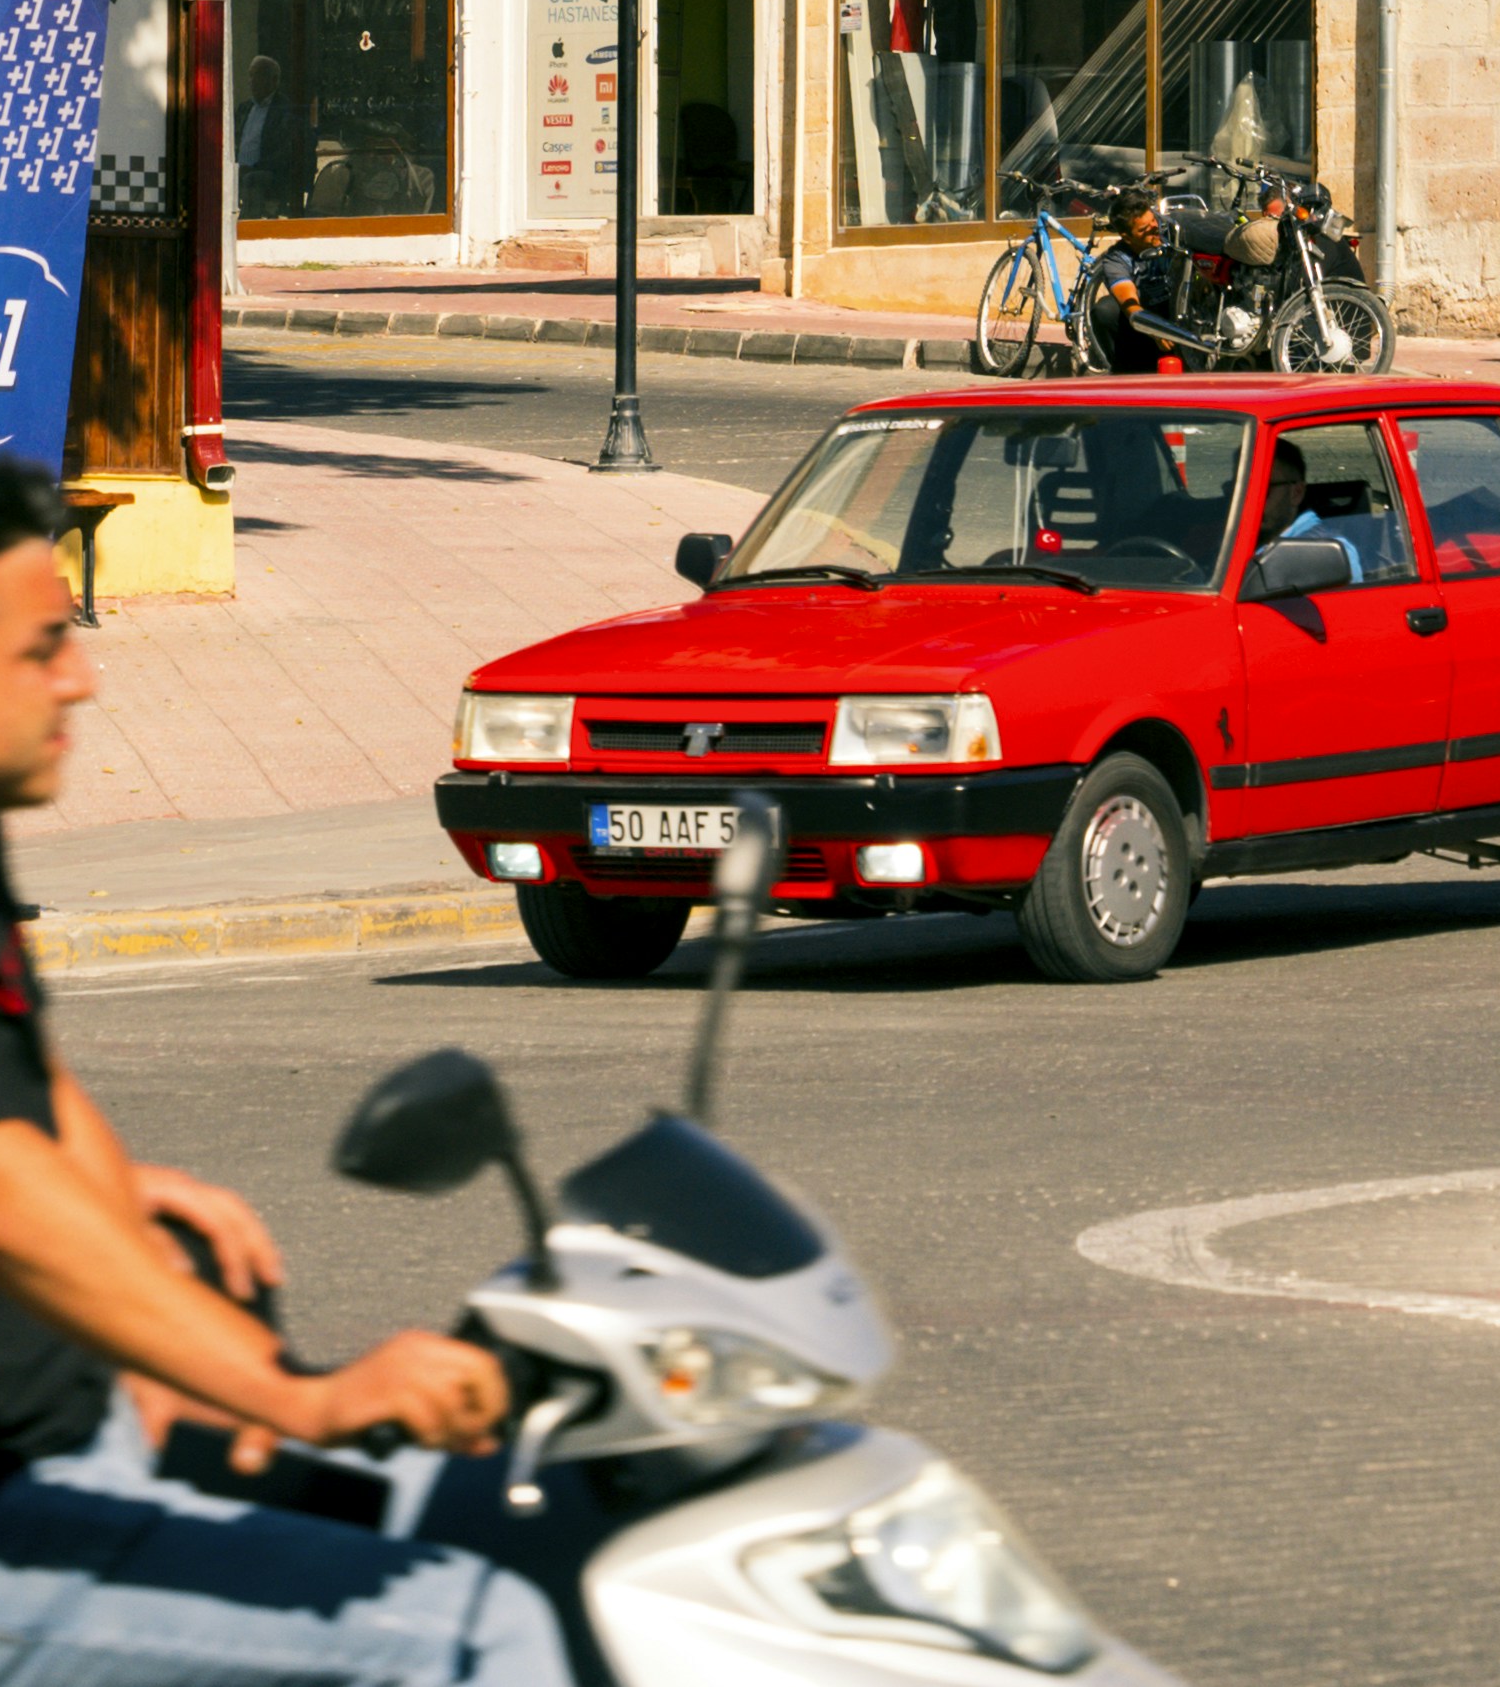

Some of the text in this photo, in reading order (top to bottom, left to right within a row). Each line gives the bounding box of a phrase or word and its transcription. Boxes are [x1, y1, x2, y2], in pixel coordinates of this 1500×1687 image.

[547, 5, 619, 24] HASTANES
[29, 29, 59, 63] +1
[66, 31, 97, 66] +1
[6, 60, 36, 95] +1
[43, 62, 72, 97] +1
[22, 94, 50, 128] +1
[57, 96, 87, 130] +1
[545, 115, 572, 125] VESTEL
[2, 125, 30, 160] +1
[36, 126, 65, 161] +1
[72, 128, 99, 163] +1
[542, 141, 573, 155] Casper
[17, 158, 45, 193] +1
[50, 160, 80, 195] +1
[543, 163, 570, 173] Lenovo
[610, 809, 736, 845] 50 AAF 5
